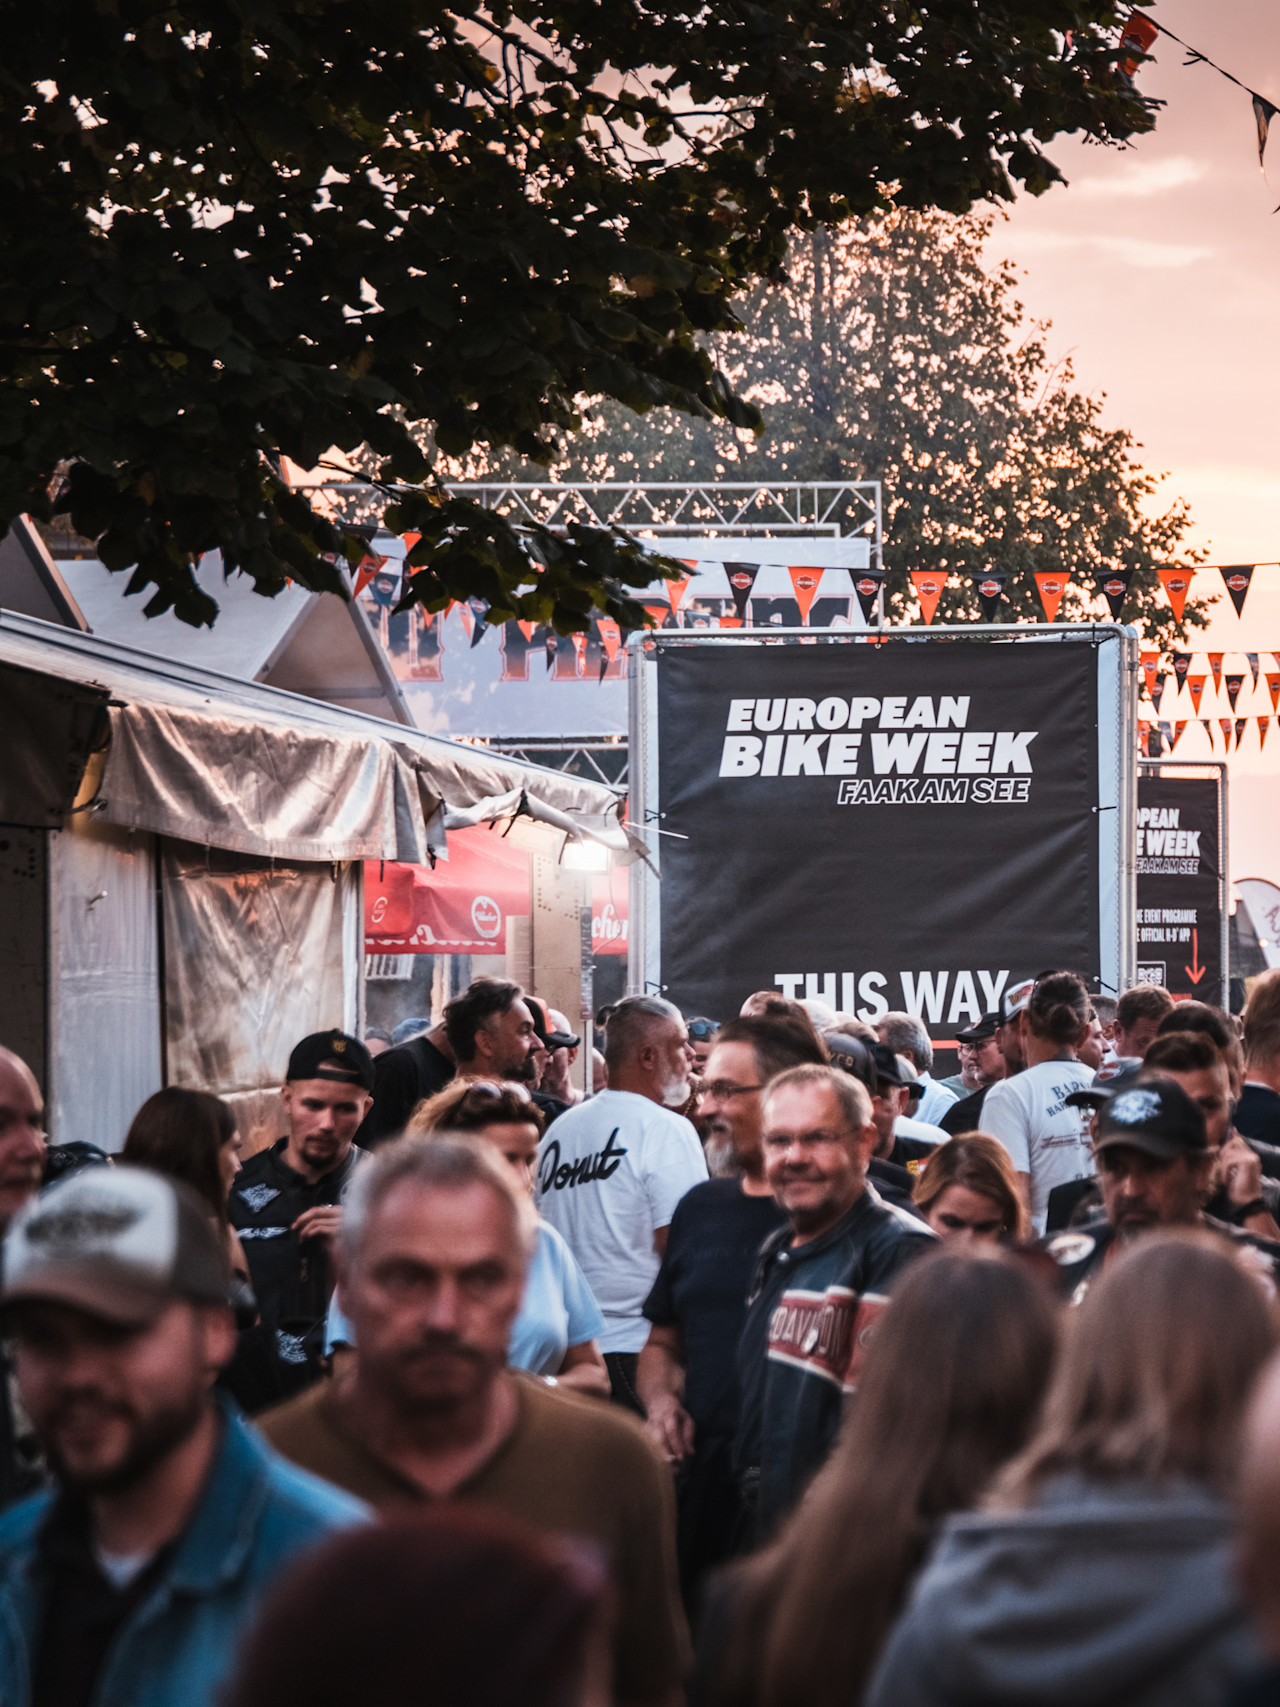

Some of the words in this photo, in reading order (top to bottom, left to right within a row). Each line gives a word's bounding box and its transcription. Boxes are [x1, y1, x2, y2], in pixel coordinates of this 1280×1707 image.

[726, 695, 971, 732] EUROPEAN
[718, 733, 863, 778] BIKE
[870, 731, 1039, 775] WEEK
[836, 778, 920, 805] FAAK
[917, 778, 969, 804] AM
[970, 777, 1032, 803] SEE
[1137, 807, 1180, 829] PEAN
[1147, 830, 1201, 857] WEEK
[1180, 858, 1199, 875] SEE
[1144, 908, 1162, 924] EVENT
[1141, 928, 1165, 943] OFFICIAL
[1179, 928, 1191, 943] APP
[773, 971, 890, 1025] THIS
[899, 970, 1011, 1024] WAY
[538, 1127, 628, 1195] Donut
